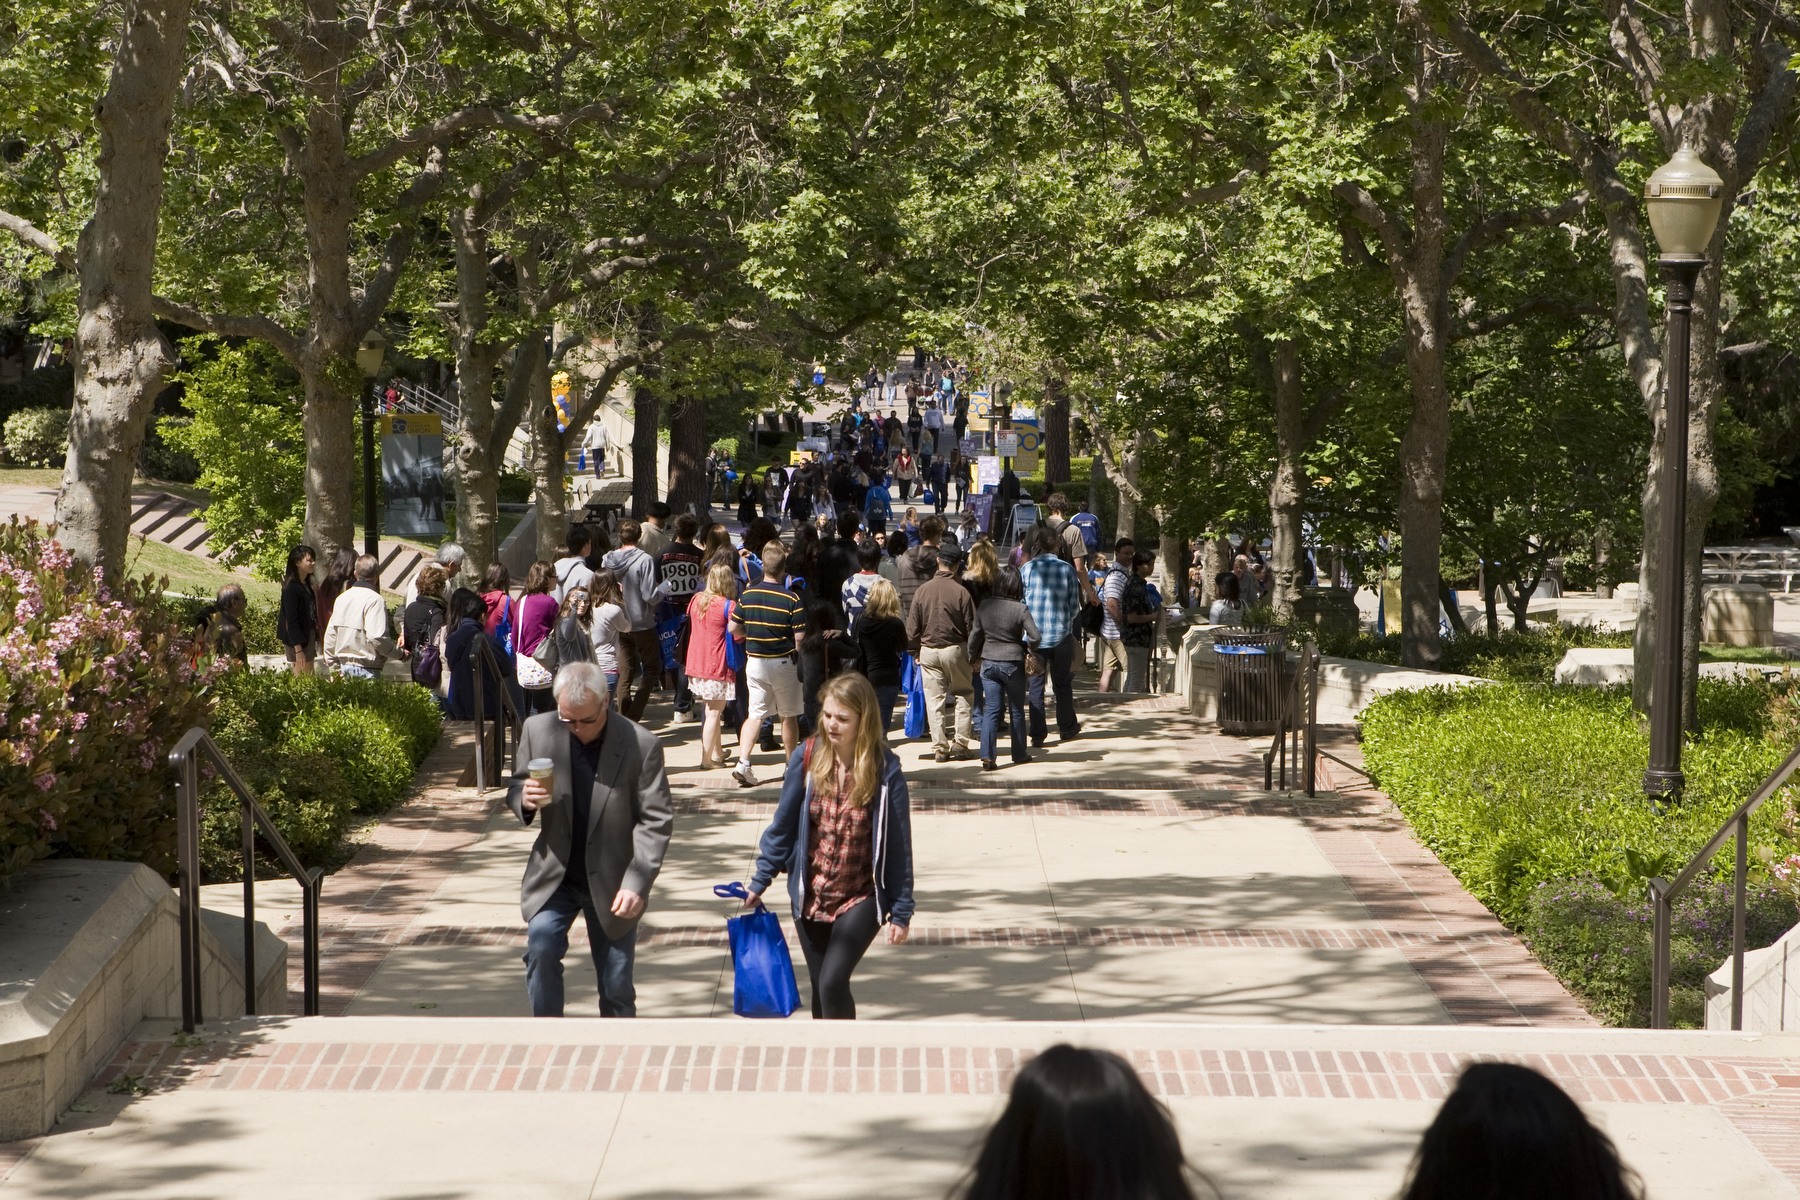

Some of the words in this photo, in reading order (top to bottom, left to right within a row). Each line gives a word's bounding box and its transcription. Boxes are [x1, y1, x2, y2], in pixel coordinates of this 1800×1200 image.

[662, 564, 697, 578] 1980
[668, 578, 697, 593] 010
[659, 630, 676, 641] UCLA
